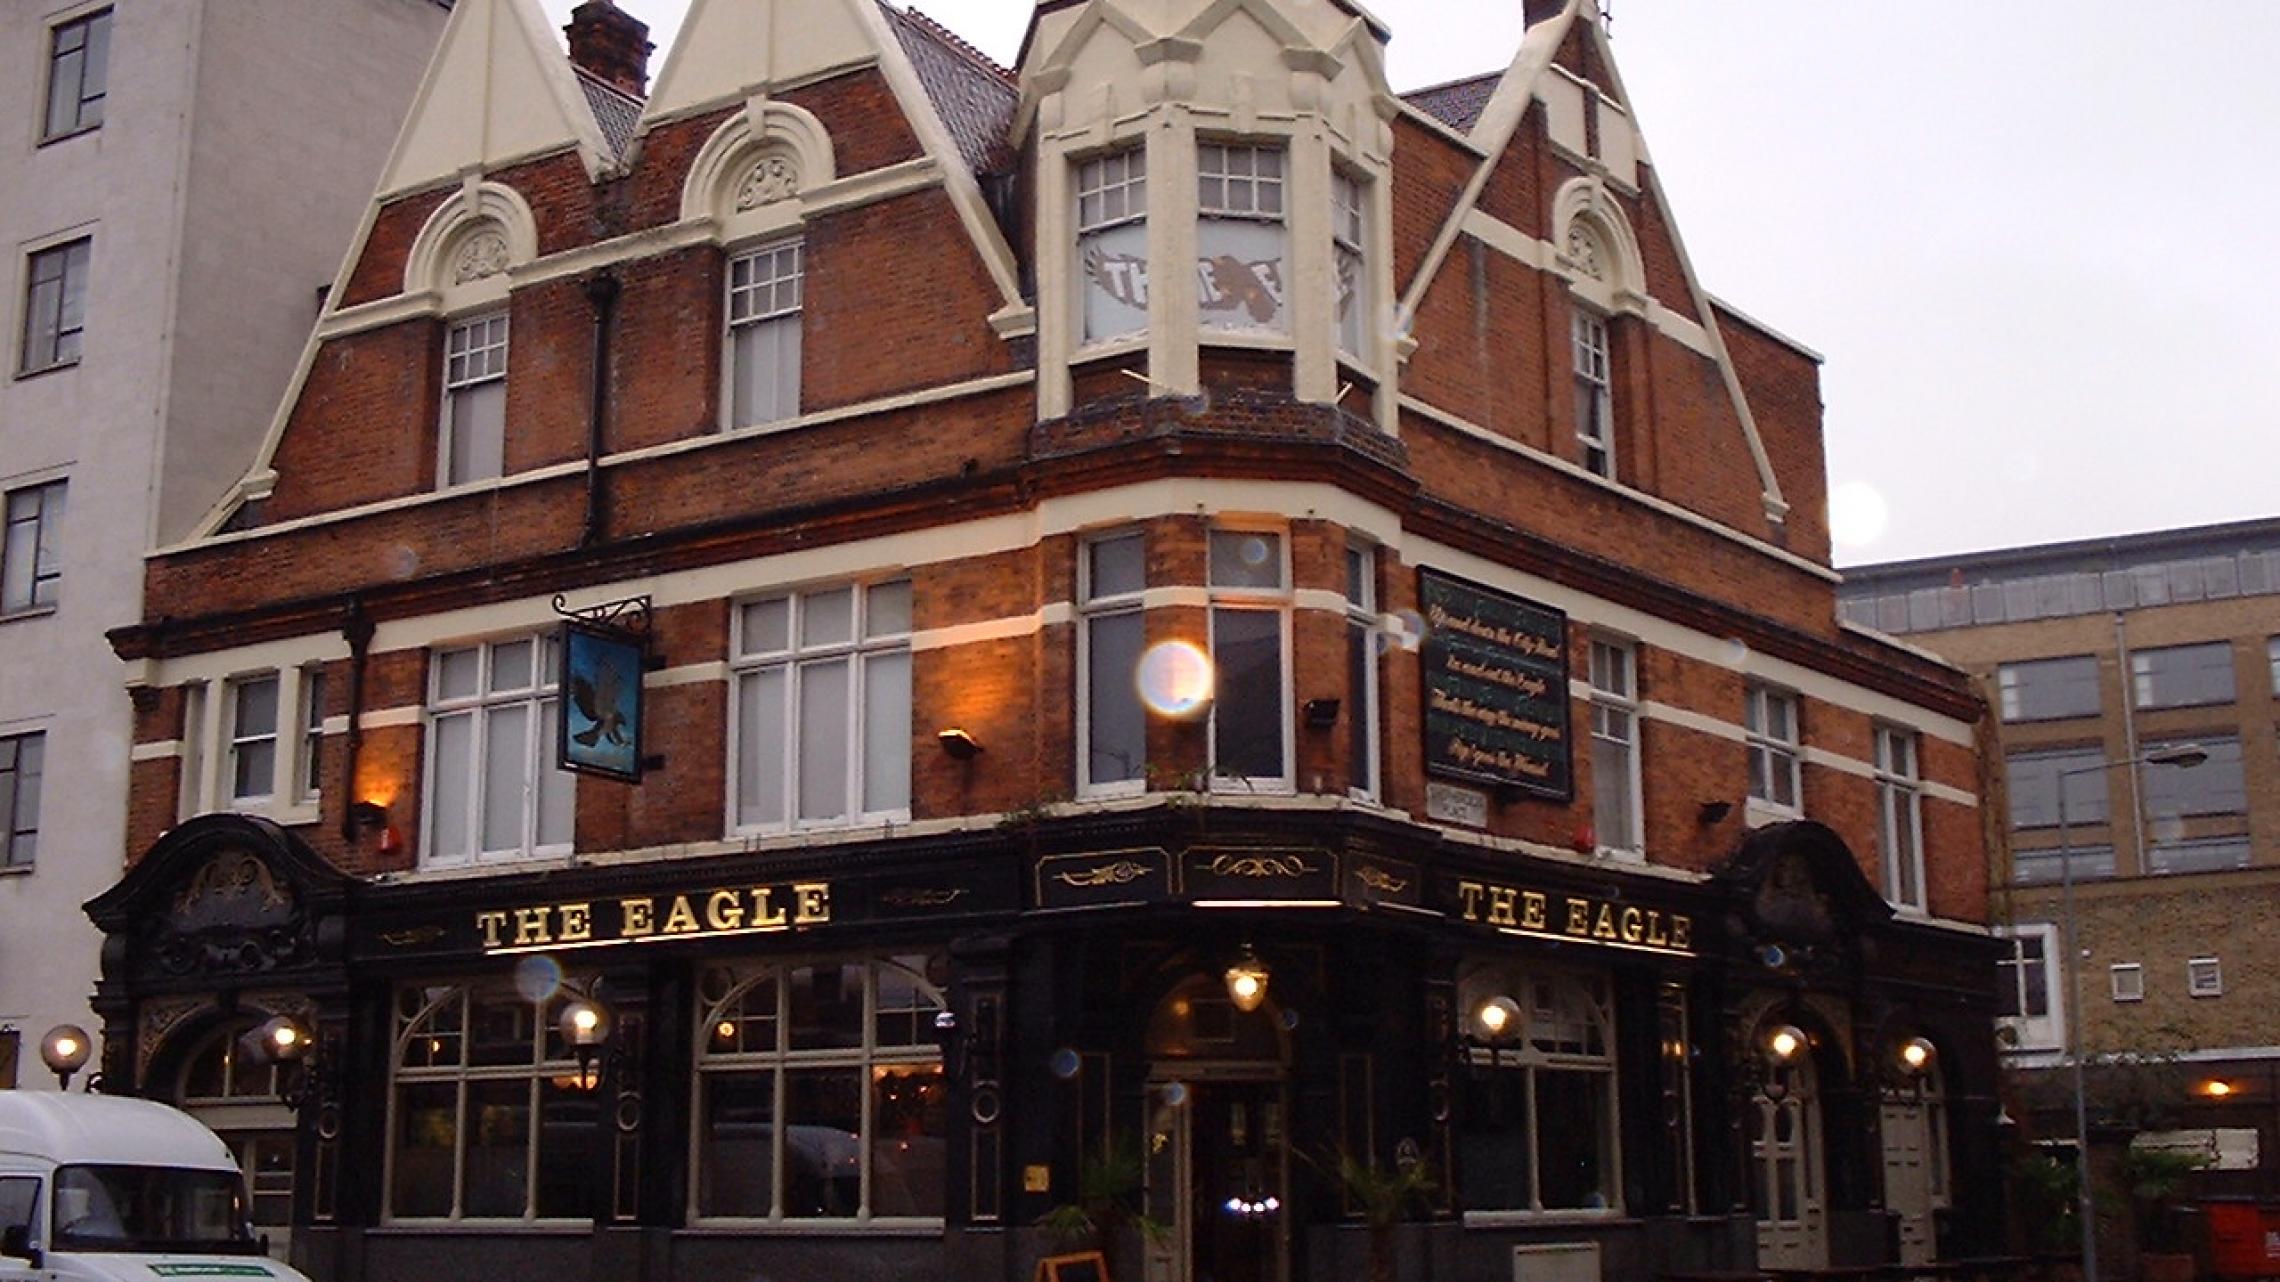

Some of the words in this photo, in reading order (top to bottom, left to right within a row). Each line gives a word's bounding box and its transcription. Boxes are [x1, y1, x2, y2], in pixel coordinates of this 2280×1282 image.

[476, 902, 592, 948] THE
[620, 882, 831, 936] EAGLE
[1459, 880, 1546, 930] THE
[1566, 898, 1691, 949] EAGLE
